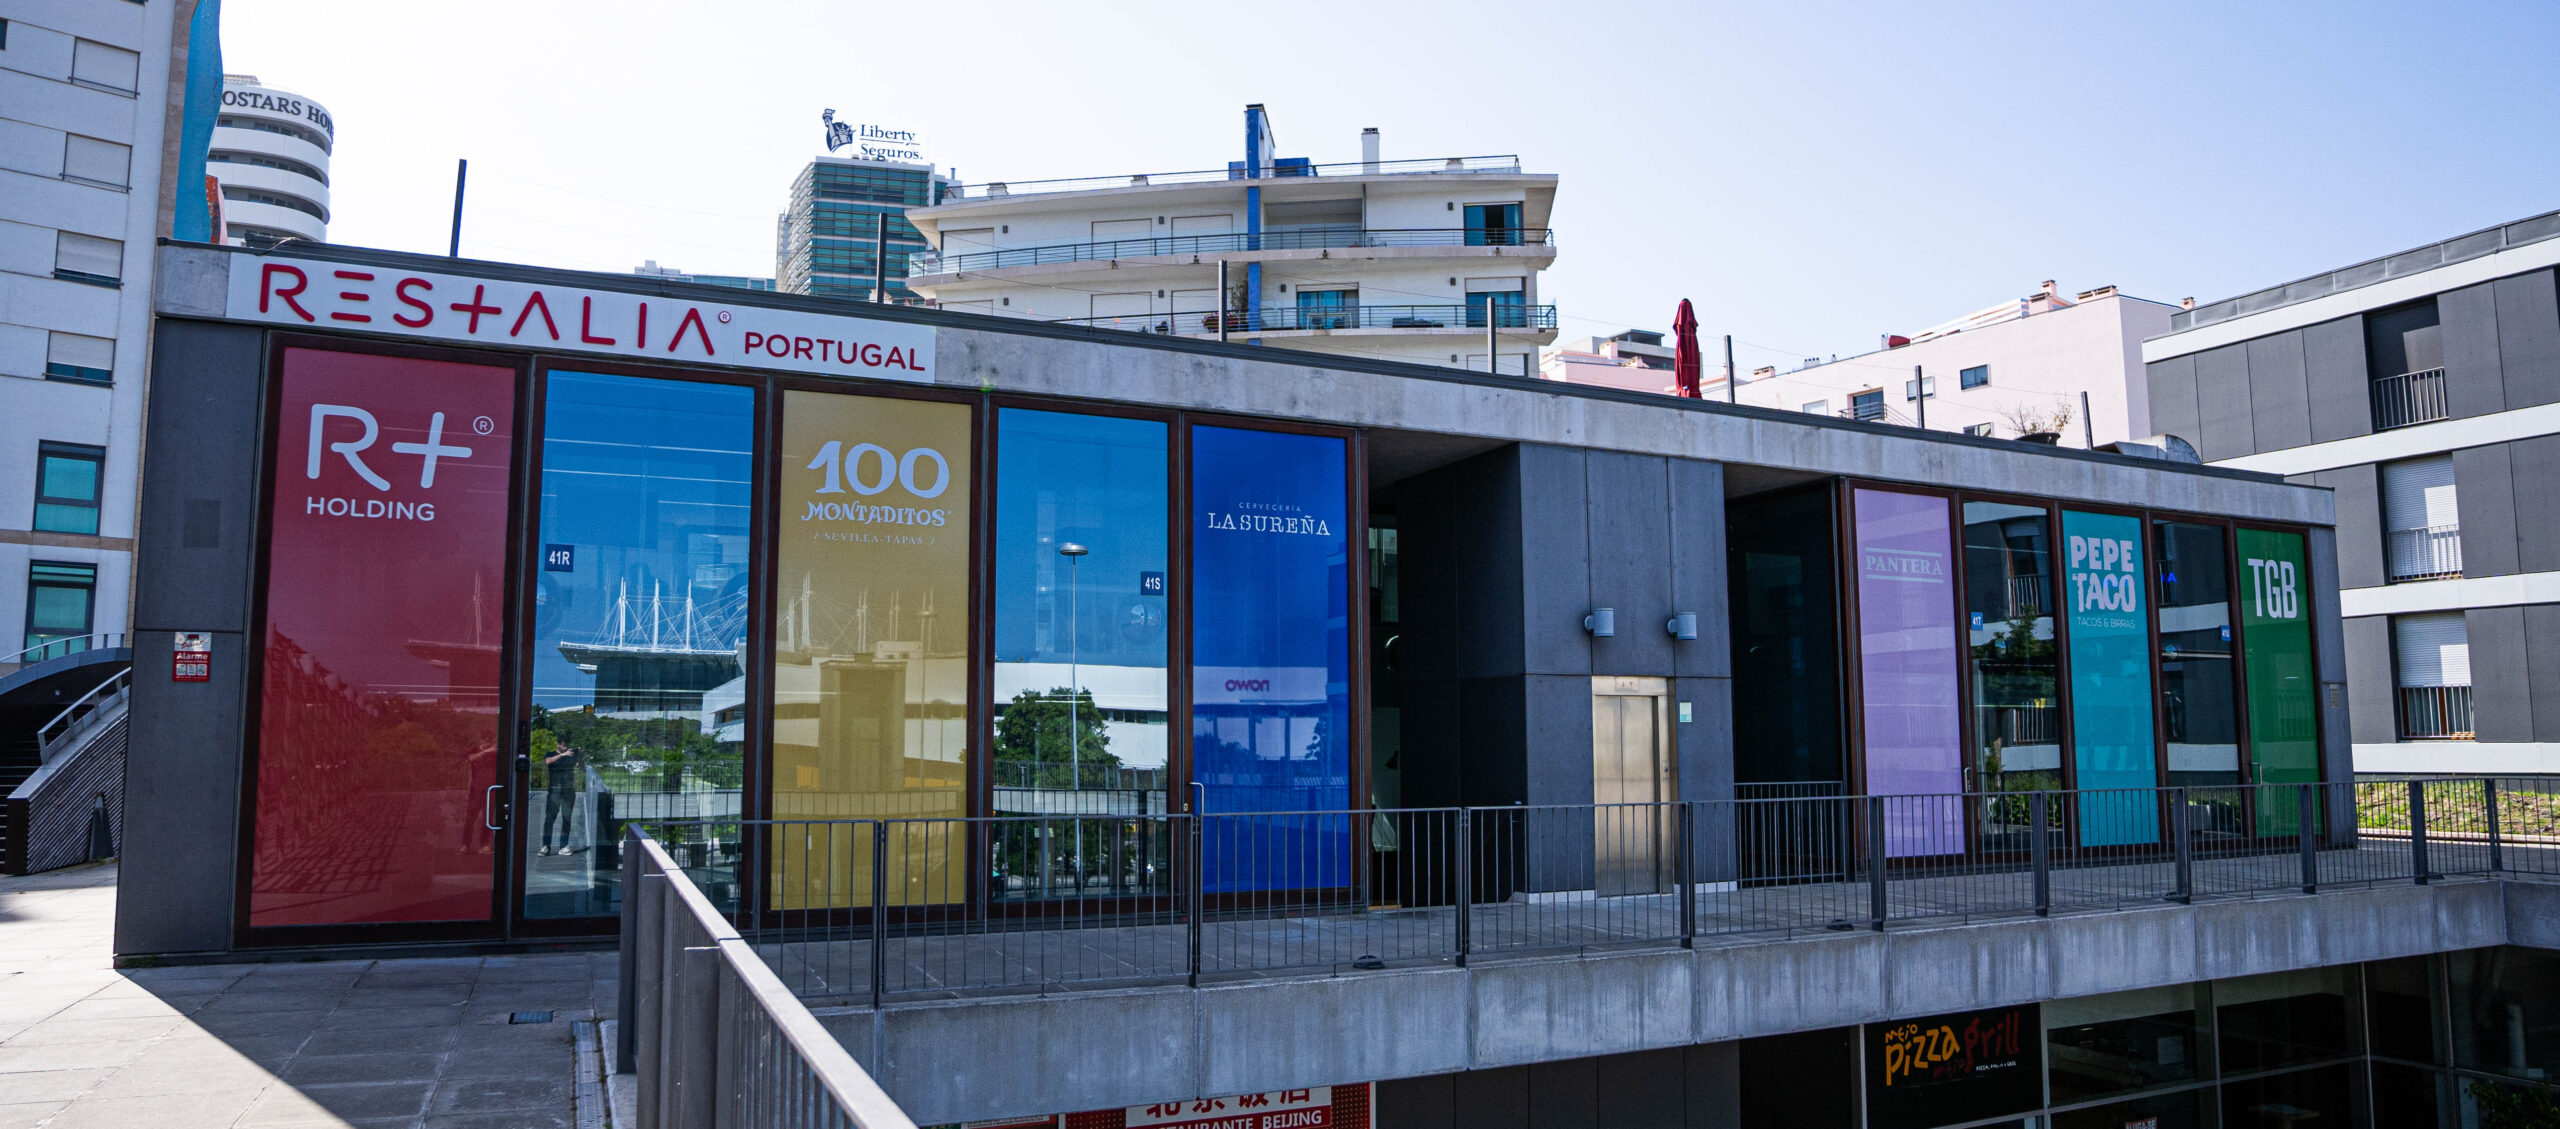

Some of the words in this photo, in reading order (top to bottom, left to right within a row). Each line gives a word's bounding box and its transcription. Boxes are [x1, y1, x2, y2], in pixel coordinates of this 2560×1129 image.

[220, 90, 302, 116] OSTARS
[860, 124, 916, 146] Liberty
[744, 331, 926, 372] PORTUGAL
[806, 440, 950, 499] 100
[306, 496, 435, 522] HOLDING
[801, 500, 946, 527] MONTADITOS
[549, 550, 570, 565] 41R
[1865, 555, 1944, 576] PANTERA
[2070, 535, 2135, 573] PEPE
[1145, 576, 1161, 590] 41S
[2072, 572, 2137, 613] TACO
[2247, 558, 2298, 619] TGB
[2077, 616, 2103, 628] TACOS
[2110, 618, 2136, 629] BIRRAS
[176, 652, 208, 660] Alarme
[1885, 1025, 1960, 1087] pizza
[1964, 1011, 2020, 1073] grill
[1262, 1109, 1322, 1129] BEIJING
